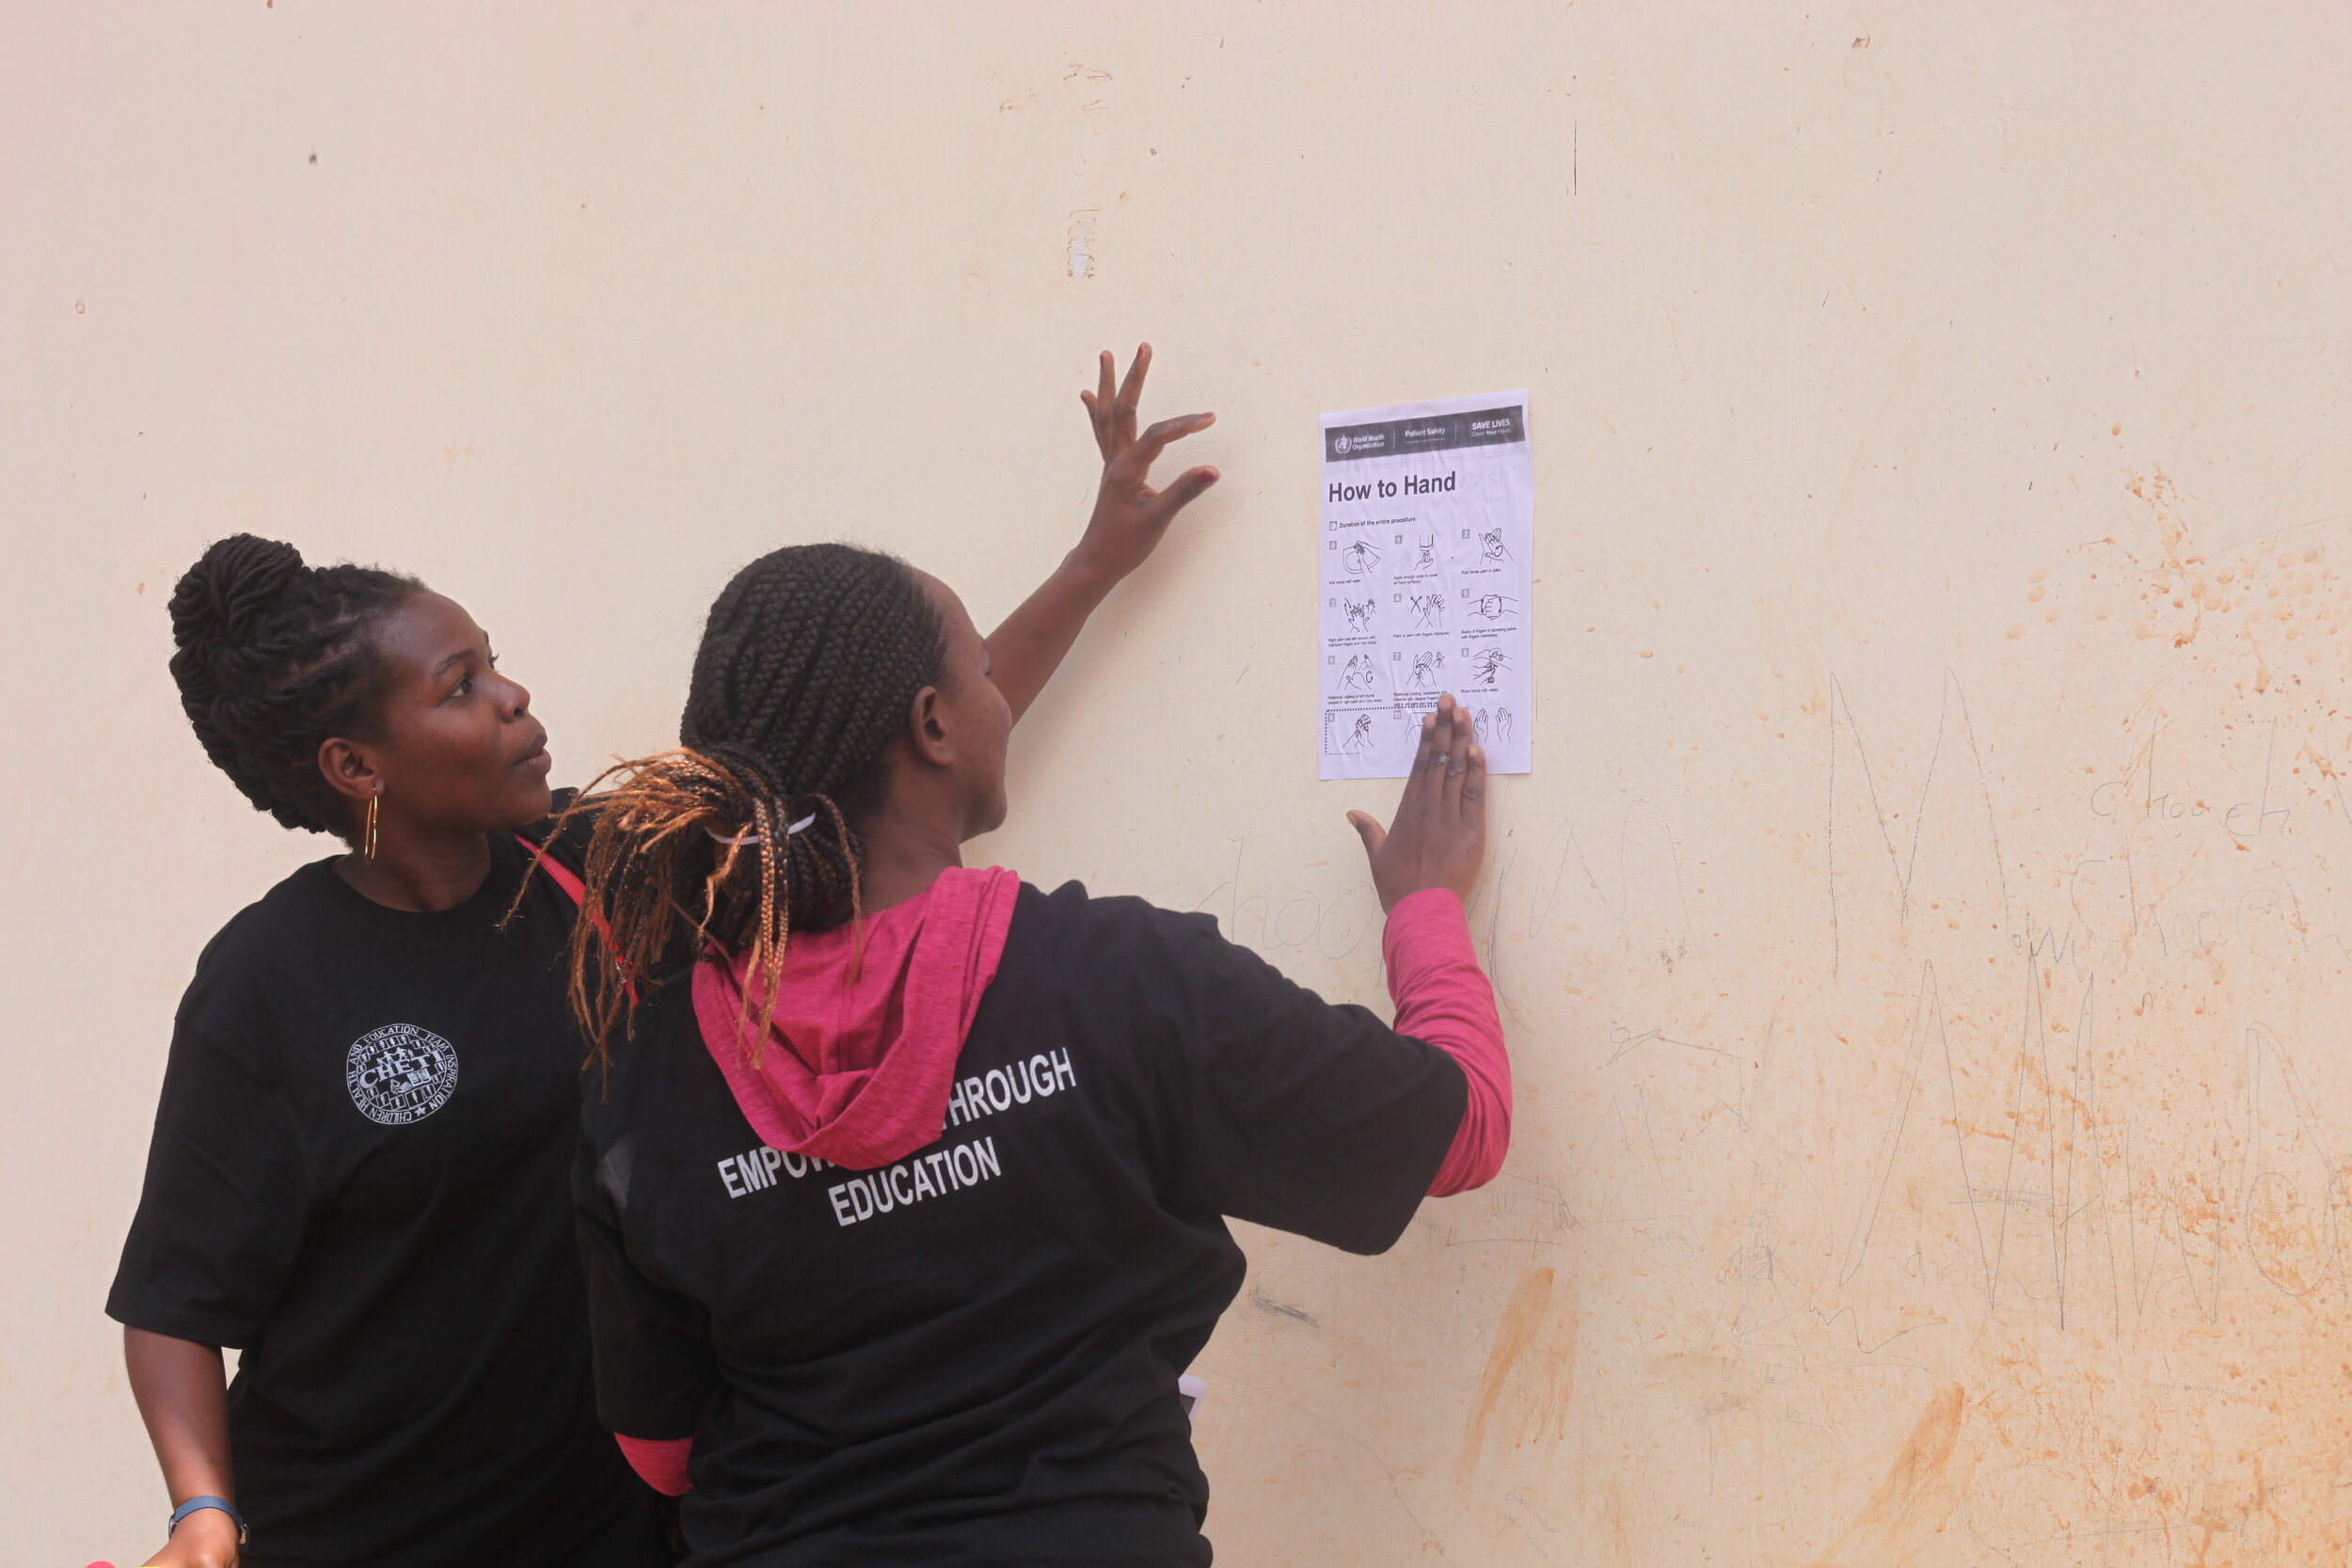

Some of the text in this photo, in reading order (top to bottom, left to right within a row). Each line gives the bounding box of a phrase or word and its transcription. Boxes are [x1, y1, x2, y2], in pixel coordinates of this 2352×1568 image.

[1405, 427, 1446, 437] Patient Safety
[1471, 419, 1511, 431] SAVE LIVES
[1352, 441, 1385, 451] Organization
[1328, 470, 1455, 503] How to Hand
[348, 1025, 455, 1123] CHILDREN HEALTH AND EDUCATION TEAM INSPIRATION
[943, 1047, 1077, 1131] HROUGH
[828, 1136, 1002, 1227] EDUCATION
